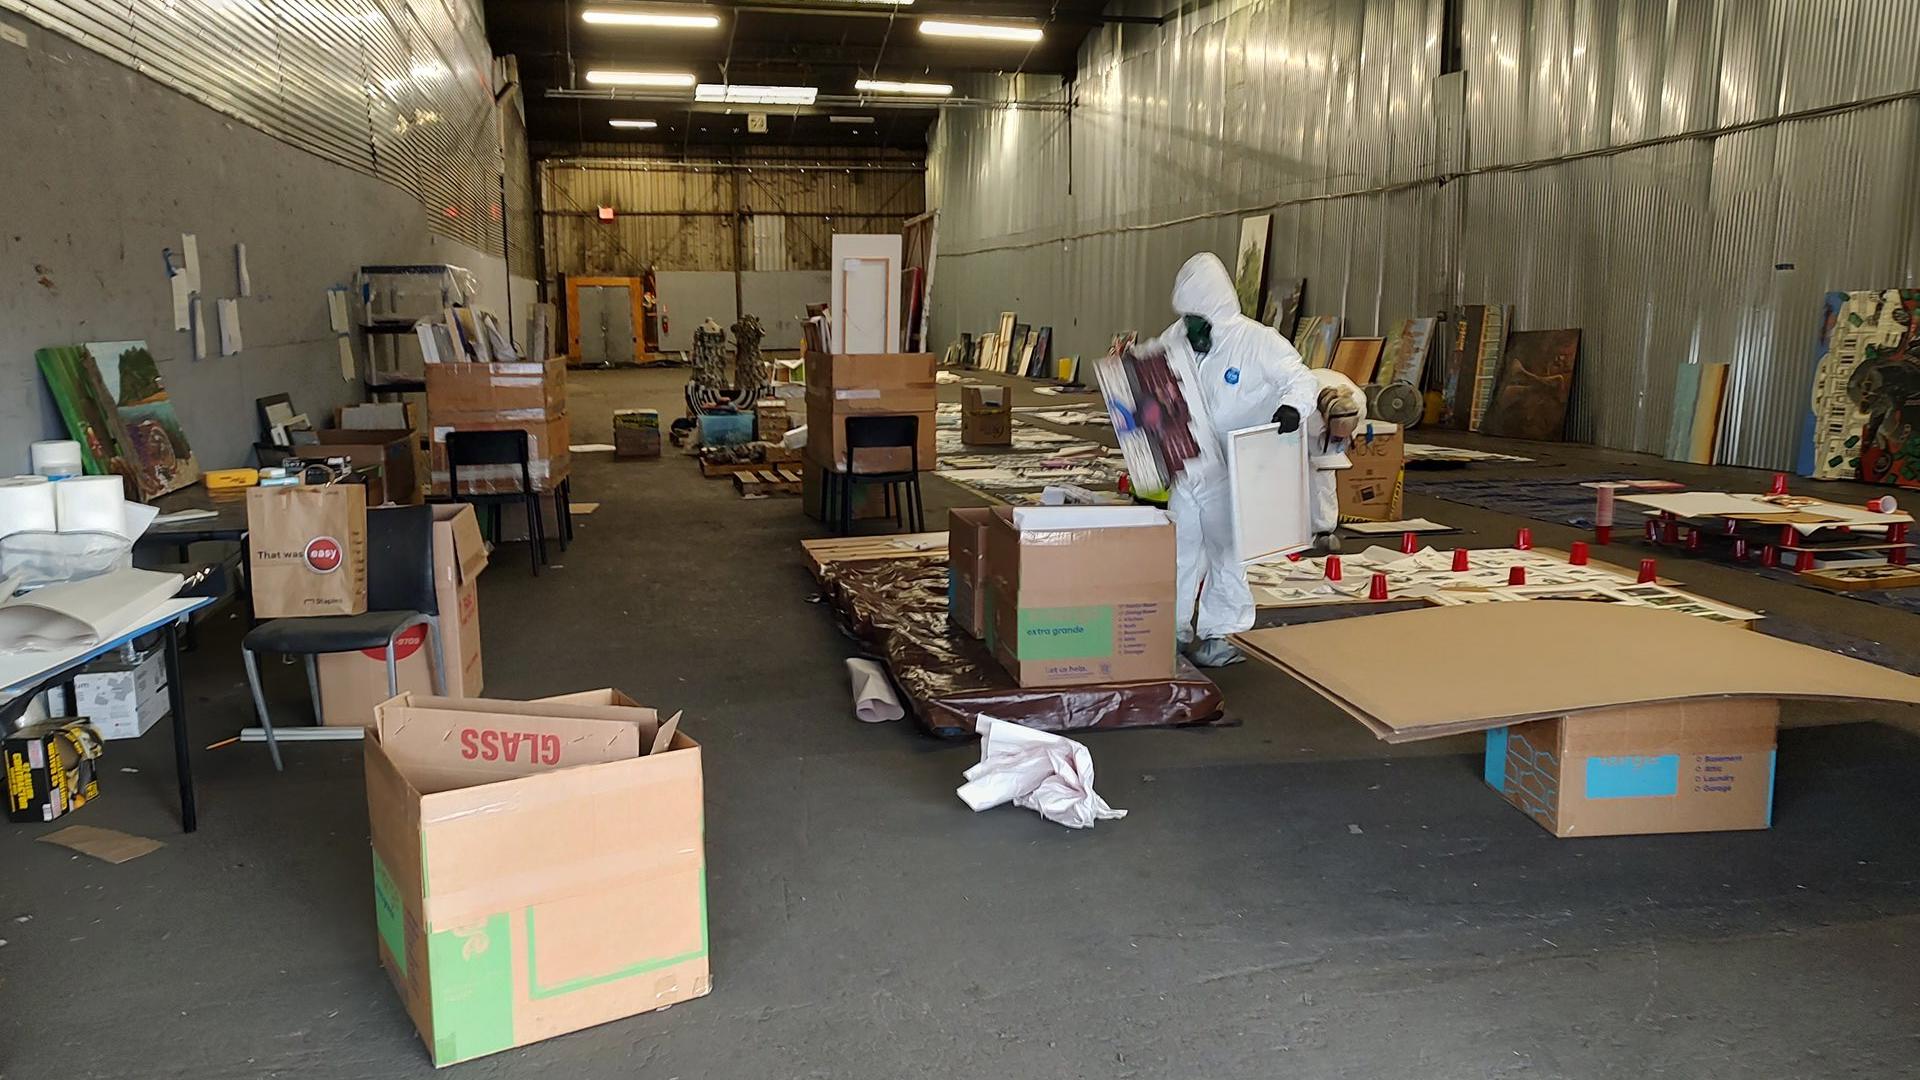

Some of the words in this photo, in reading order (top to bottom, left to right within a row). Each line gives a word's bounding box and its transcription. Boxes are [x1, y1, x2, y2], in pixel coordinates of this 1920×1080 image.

[257, 551, 281, 559] That
[310, 549, 337, 560] easy
[1026, 628, 1051, 636] extra
[1051, 625, 1085, 637] grande
[460, 728, 561, 766] GLASS
